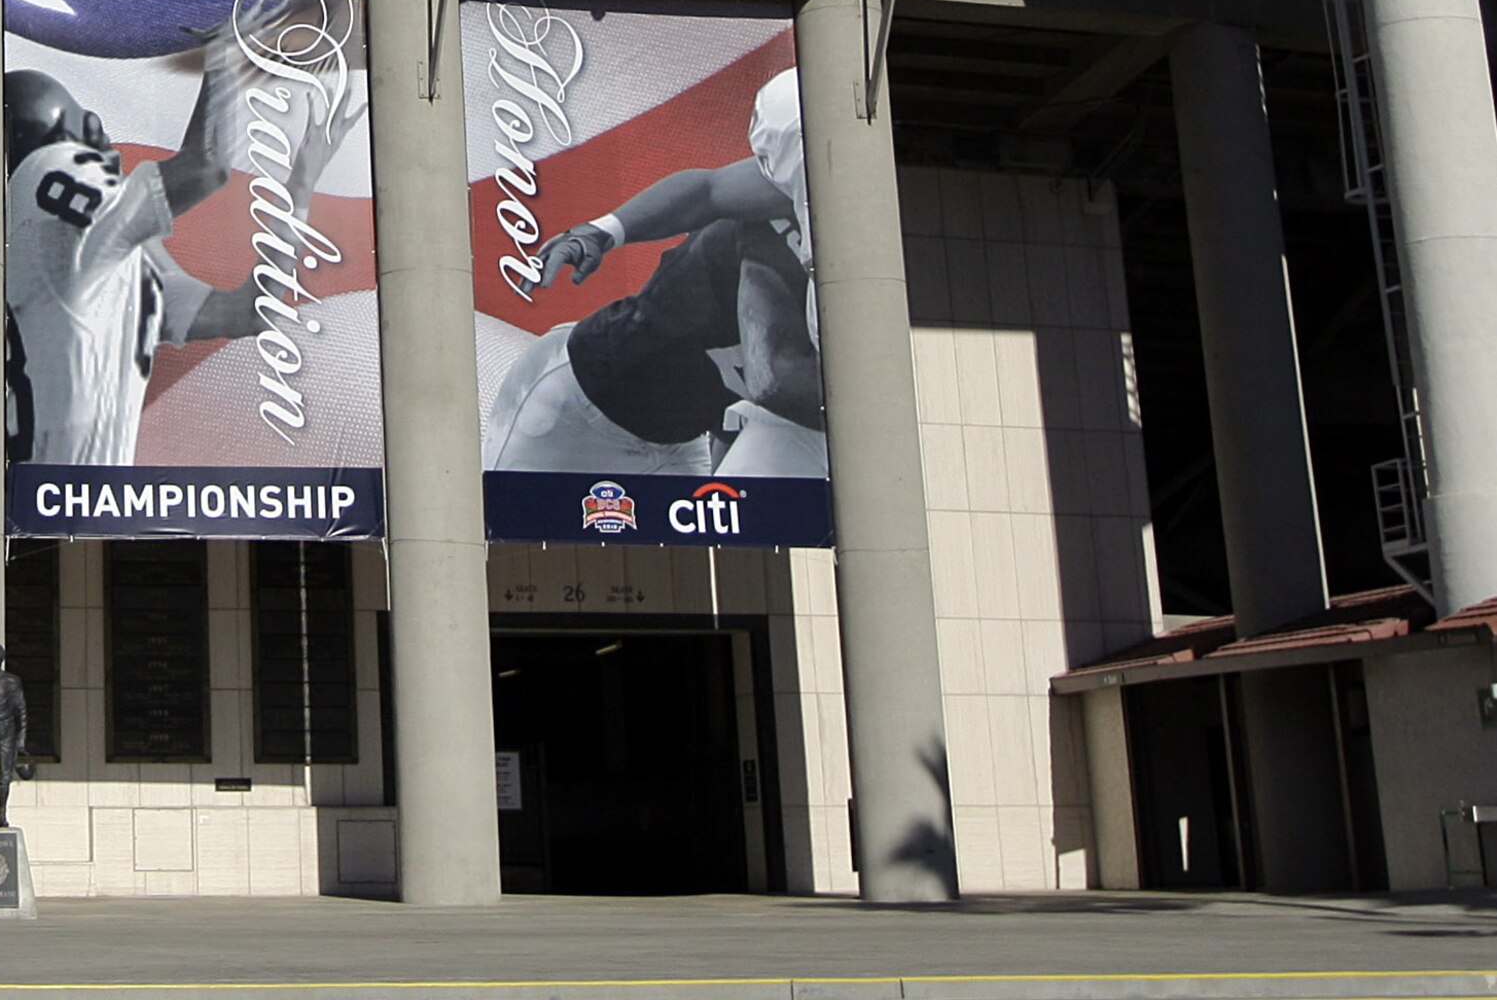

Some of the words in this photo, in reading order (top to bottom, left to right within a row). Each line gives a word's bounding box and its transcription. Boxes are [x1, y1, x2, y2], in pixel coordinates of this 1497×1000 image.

[35, 482, 356, 520] CHAMPIONSHIP
[668, 490, 741, 535] citi
[563, 583, 586, 602] 26
